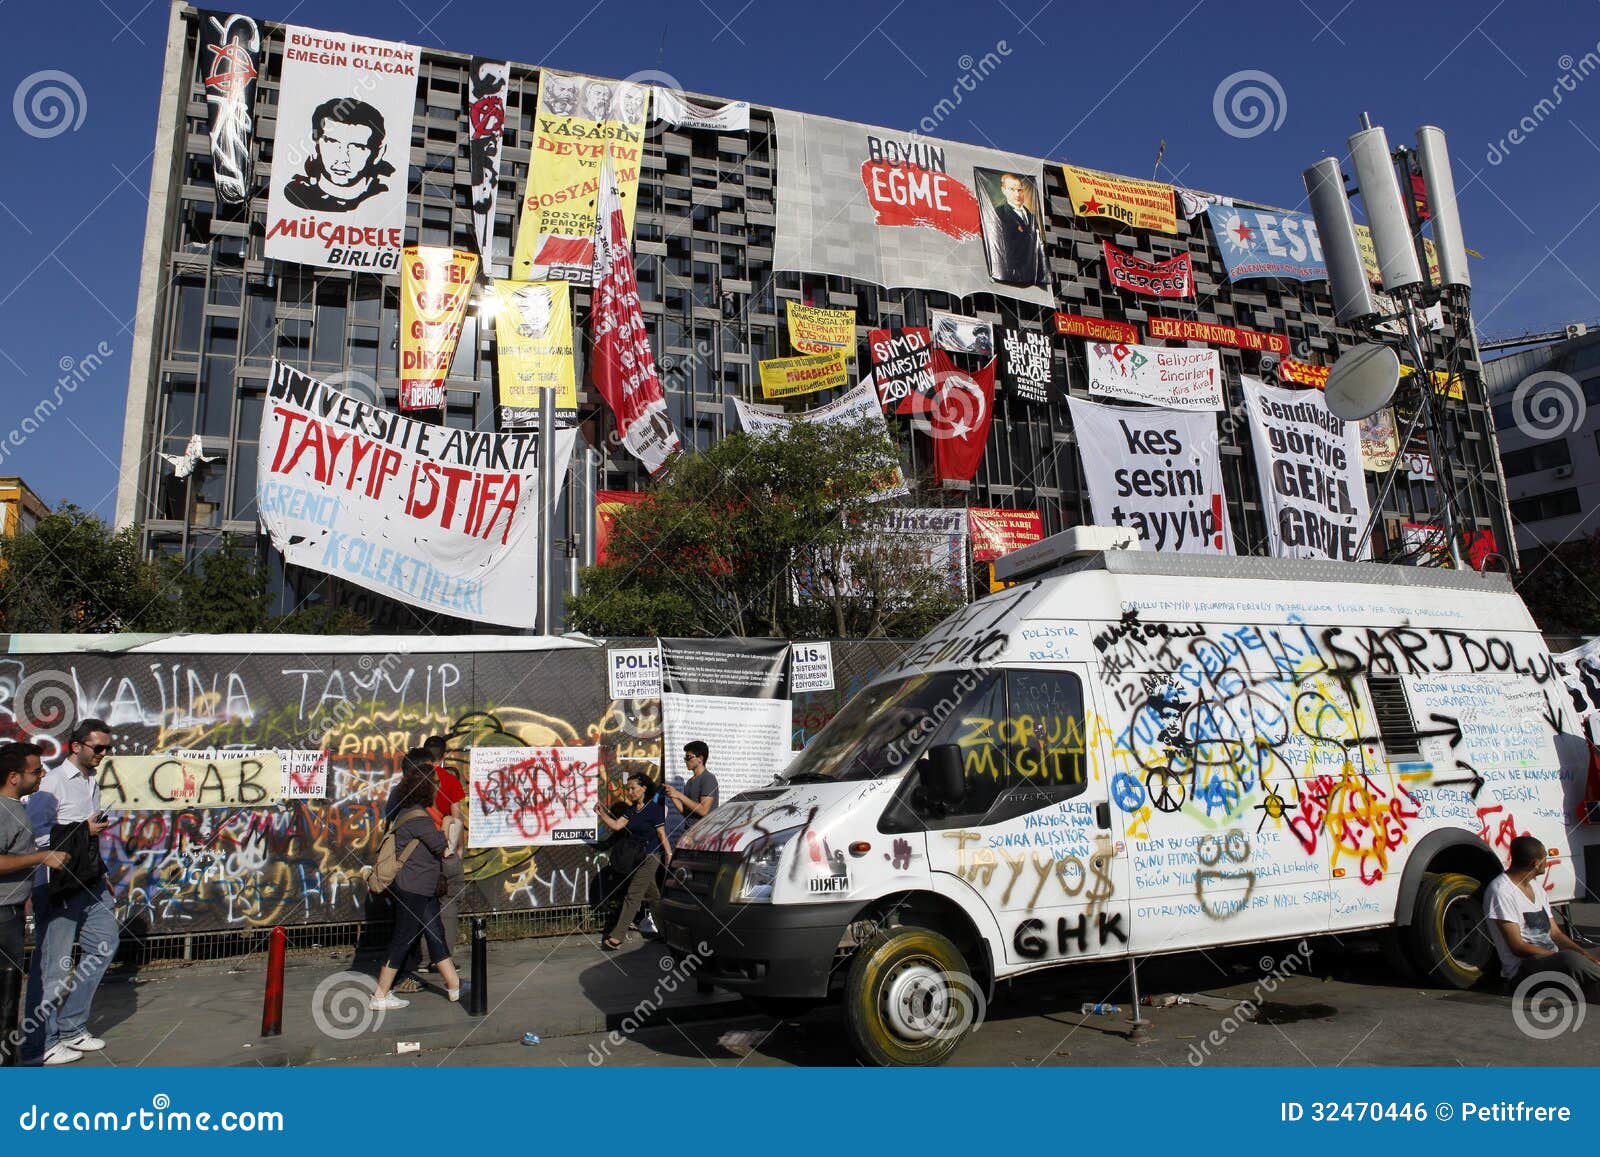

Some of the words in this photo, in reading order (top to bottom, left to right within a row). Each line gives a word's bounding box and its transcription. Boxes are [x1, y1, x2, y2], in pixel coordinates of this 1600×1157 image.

[291, 34, 346, 51] BÜTÜN
[286, 48, 347, 67] EMEĞİN
[352, 57, 415, 77] OLACAK
[578, 159, 598, 168] VE
[867, 135, 946, 174] BOYUN
[1106, 203, 1134, 224] TÖPG
[266, 216, 401, 248] MÜCADELE
[327, 246, 401, 271] BİRLİĞİ
[1157, 350, 1214, 368] Geliyoruz
[879, 367, 936, 405] ZAMAN
[1118, 419, 1182, 455] kes
[1268, 422, 1349, 471] göreve
[1114, 458, 1204, 497] sesini
[988, 832, 1031, 849] SONRA
[1013, 911, 1128, 960] GHK
